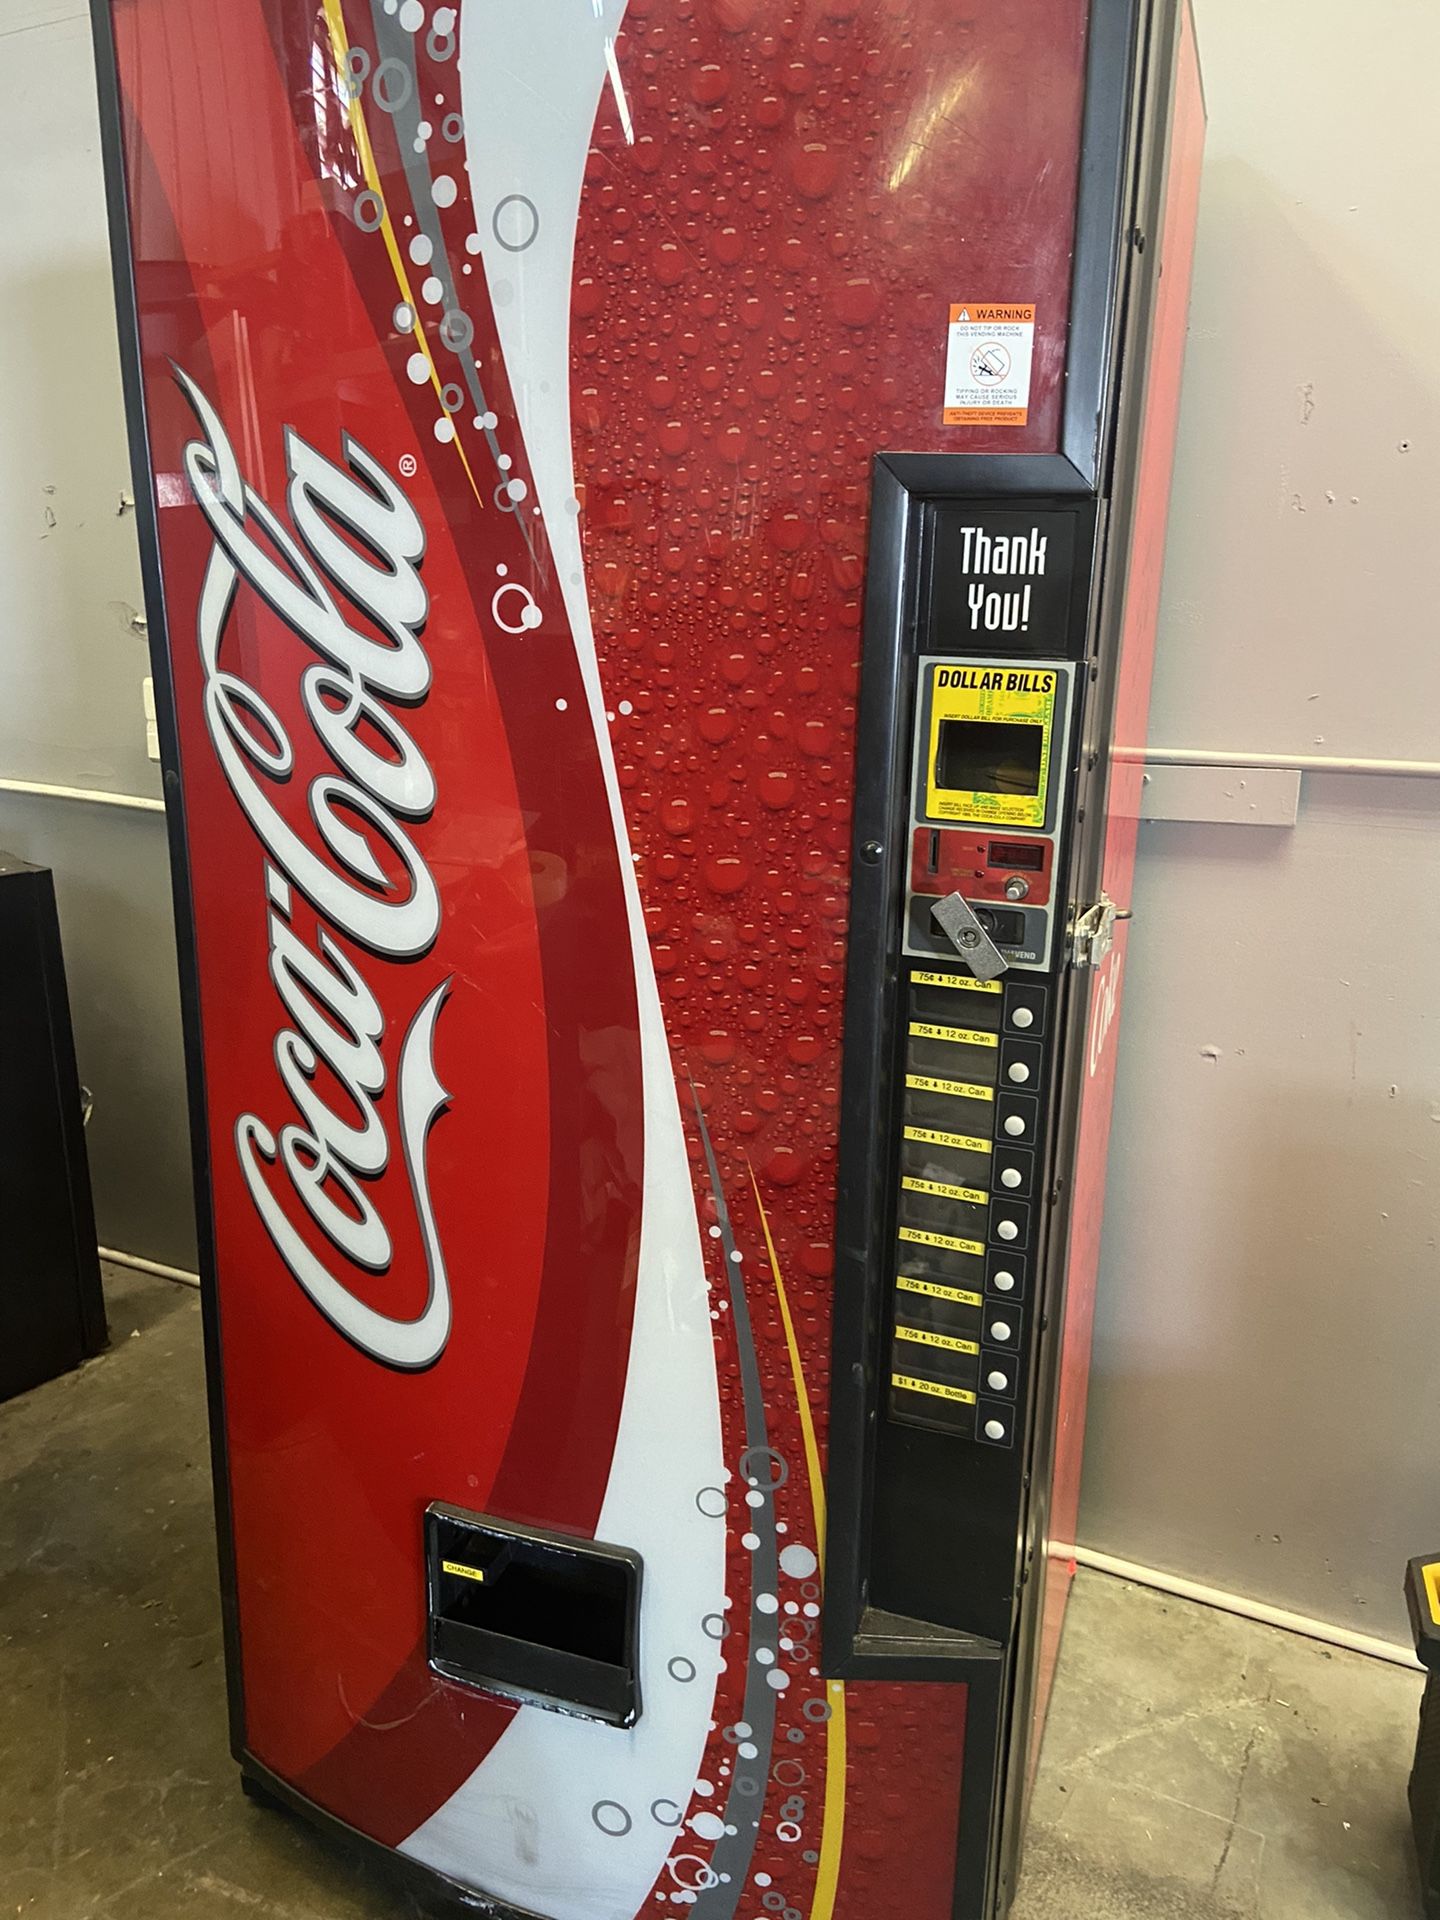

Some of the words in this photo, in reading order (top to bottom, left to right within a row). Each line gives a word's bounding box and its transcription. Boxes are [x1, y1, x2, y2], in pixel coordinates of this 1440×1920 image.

[976, 309, 1032, 319] WARNING
[960, 527, 1047, 575] Thank
[967, 583, 1031, 631] You!
[938, 670, 1003, 691] DOLLAR
[1006, 673, 1053, 693] BILLS
[167, 358, 454, 1373] Coca-Cola
[947, 976, 957, 985] 12
[960, 979, 972, 987] oz.
[974, 980, 992, 989] Can
[946, 1028, 956, 1038] 12
[973, 1033, 990, 1043] Can
[942, 1081, 952, 1090] 12
[953, 1085, 966, 1093] oz.
[968, 1086, 986, 1096] Can
[939, 1134, 950, 1143] 12
[951, 1137, 962, 1145] oz.
[965, 1139, 983, 1149] Can
[937, 1185, 947, 1194] 12
[948, 1188, 961, 1196] oz.
[963, 1190, 980, 1200] Can
[933, 1236, 943, 1245] 12
[944, 1239, 957, 1248] oz.
[959, 1241, 976, 1251] Can
[932, 1285, 942, 1295] 12
[943, 1289, 956, 1297] oz.
[957, 1291, 974, 1302] Can
[930, 1335, 940, 1344] 12
[941, 1339, 954, 1347] oz.
[955, 1341, 973, 1351] Can
[898, 1377, 907, 1386] $1
[919, 1381, 929, 1391] 20
[931, 1386, 942, 1394] oz.
[945, 1388, 968, 1400] Bottle
[446, 1564, 476, 1577] CHANGE
